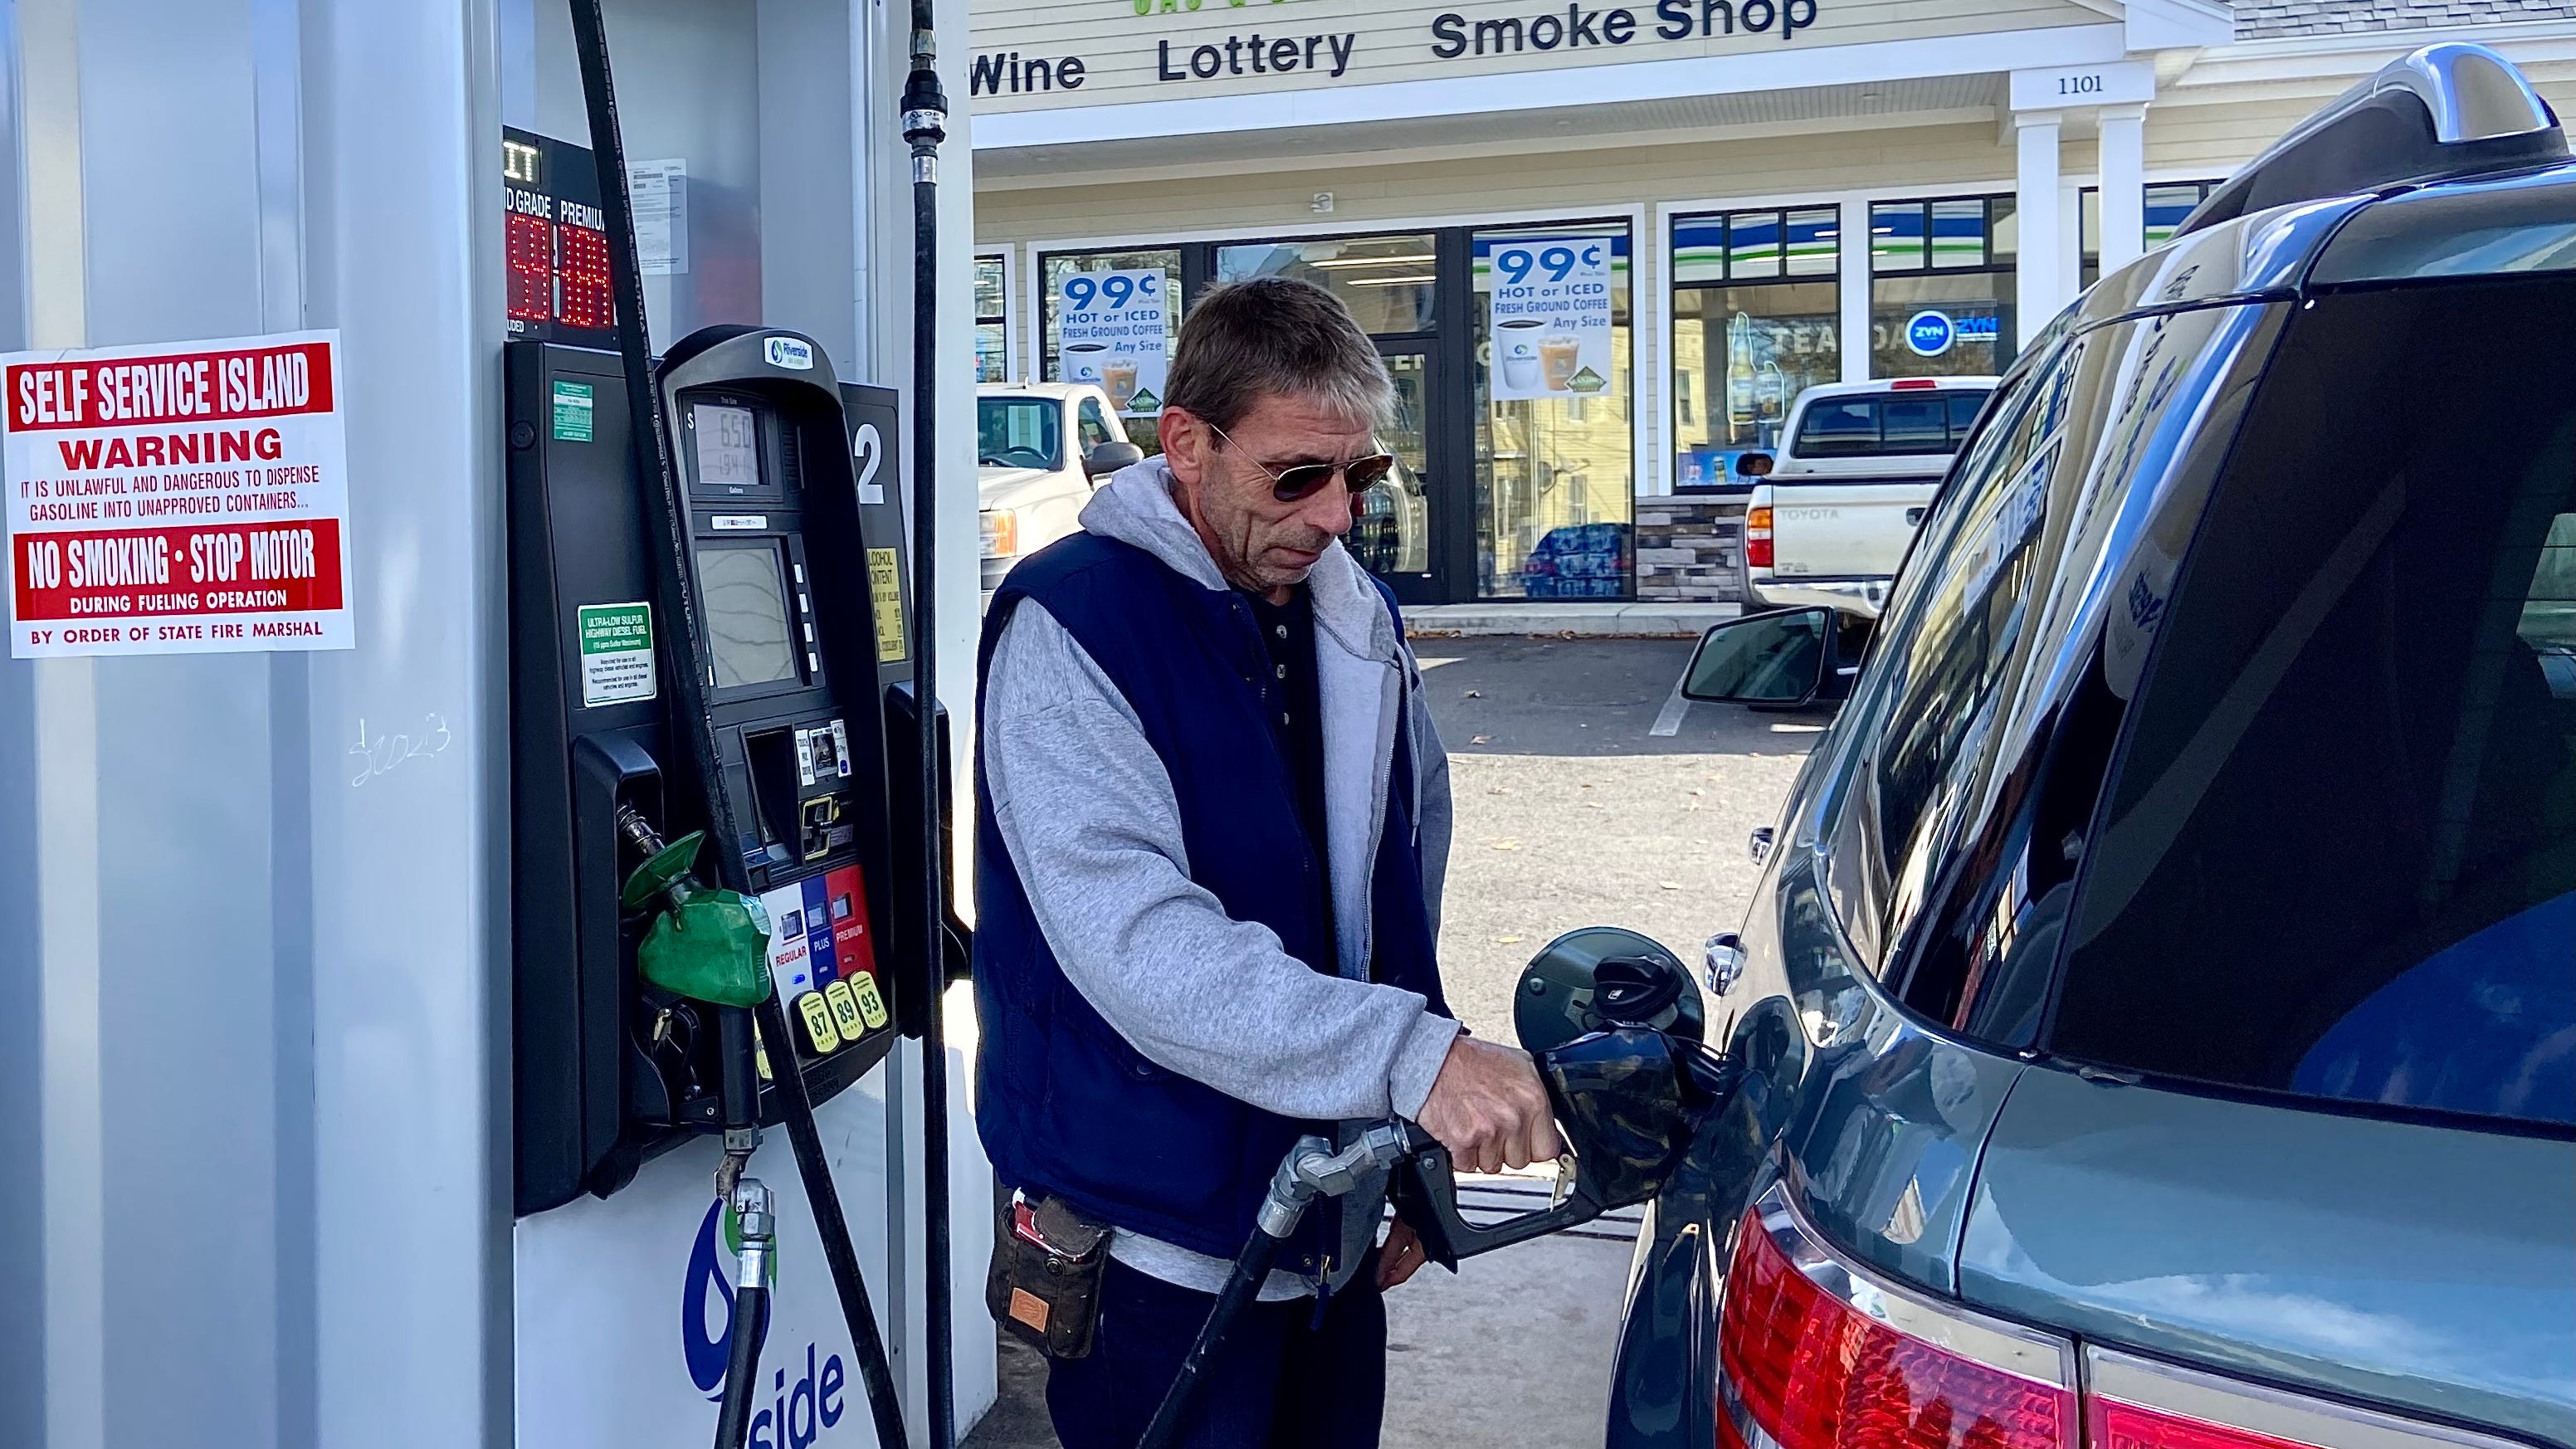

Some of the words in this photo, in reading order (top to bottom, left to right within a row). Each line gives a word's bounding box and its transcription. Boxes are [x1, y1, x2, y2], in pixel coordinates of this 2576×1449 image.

[969, 53, 1086, 95] Wine
[1159, 33, 1355, 81] Lottery
[1432, 2, 1636, 58] Smoke
[1656, 0, 1817, 40] Shop
[2058, 75, 2103, 95] 1101
[502, 140, 537, 182] IT
[515, 191, 552, 219] GRADE
[560, 200, 605, 232] PREMIU
[1497, 244, 1600, 285] 99¢
[1065, 274, 1156, 310] 99¢
[1499, 287, 1534, 299] HOT
[1541, 289, 1559, 297] or
[1566, 284, 1604, 295] ICED
[1066, 313, 1098, 324] HOT
[1104, 314, 1120, 323] or
[1125, 310, 1159, 321] ICED
[1495, 302, 1524, 315] FRESH
[1527, 300, 1570, 312] GROUND
[1573, 299, 1608, 310] COFFEE
[1063, 327, 1088, 339] FRESH
[1090, 325, 1129, 337] GROUND
[1132, 324, 1163, 335] COFFEE
[1554, 317, 1577, 330] Any
[1581, 315, 1607, 327] Size
[1915, 326, 1944, 337] ZYN
[783, 342, 807, 359] Riverside
[1115, 341, 1135, 354] Any
[1139, 339, 1162, 351] Size
[20, 368, 88, 424] SELF
[98, 360, 210, 421] SERVICE
[219, 353, 309, 412] ISLAND
[687, 412, 695, 430] $
[58, 428, 282, 471] WARNING
[855, 423, 885, 504] 2
[21, 481, 29, 499] IT
[36, 481, 48, 497] IS
[56, 476, 128, 496] UNLAWFUL
[133, 475, 158, 493] AND
[163, 471, 240, 491] DANGEROUS
[245, 470, 261, 487] TO
[267, 466, 320, 486] DISPENSE
[30, 501, 98, 522] GASOLINE
[104, 500, 132, 519] INTO
[137, 495, 220, 517] UNAPPROVED
[1778, 508, 1838, 520] TOYOTA
[28, 540, 61, 589] NO
[68, 535, 169, 588] SMOKING
[190, 533, 243, 583] STOP
[250, 529, 315, 580] MOTOR
[71, 594, 131, 614] DURING
[138, 593, 199, 612] FUELING
[206, 589, 287, 608] OPERATION
[585, 627, 612, 638] HIGHWAY
[612, 626, 632, 637] DIESEL
[632, 625, 646, 635] FUEL
[588, 617, 621, 627] ULTRA-LOW
[621, 615, 643, 625] SULFUR
[31, 631, 53, 645] BY
[63, 627, 120, 643] ORDER
[129, 627, 150, 642] OF
[159, 625, 202, 641] STATE
[212, 624, 243, 639] FIRE
[253, 621, 323, 638] MARSHAL
[836, 925, 863, 943] PREMIUM
[776, 946, 807, 967] REGULAR
[814, 937, 830, 951] PLUS
[837, 1000, 855, 1023] 89
[861, 991, 879, 1014] 93
[811, 1011, 827, 1037] 87
